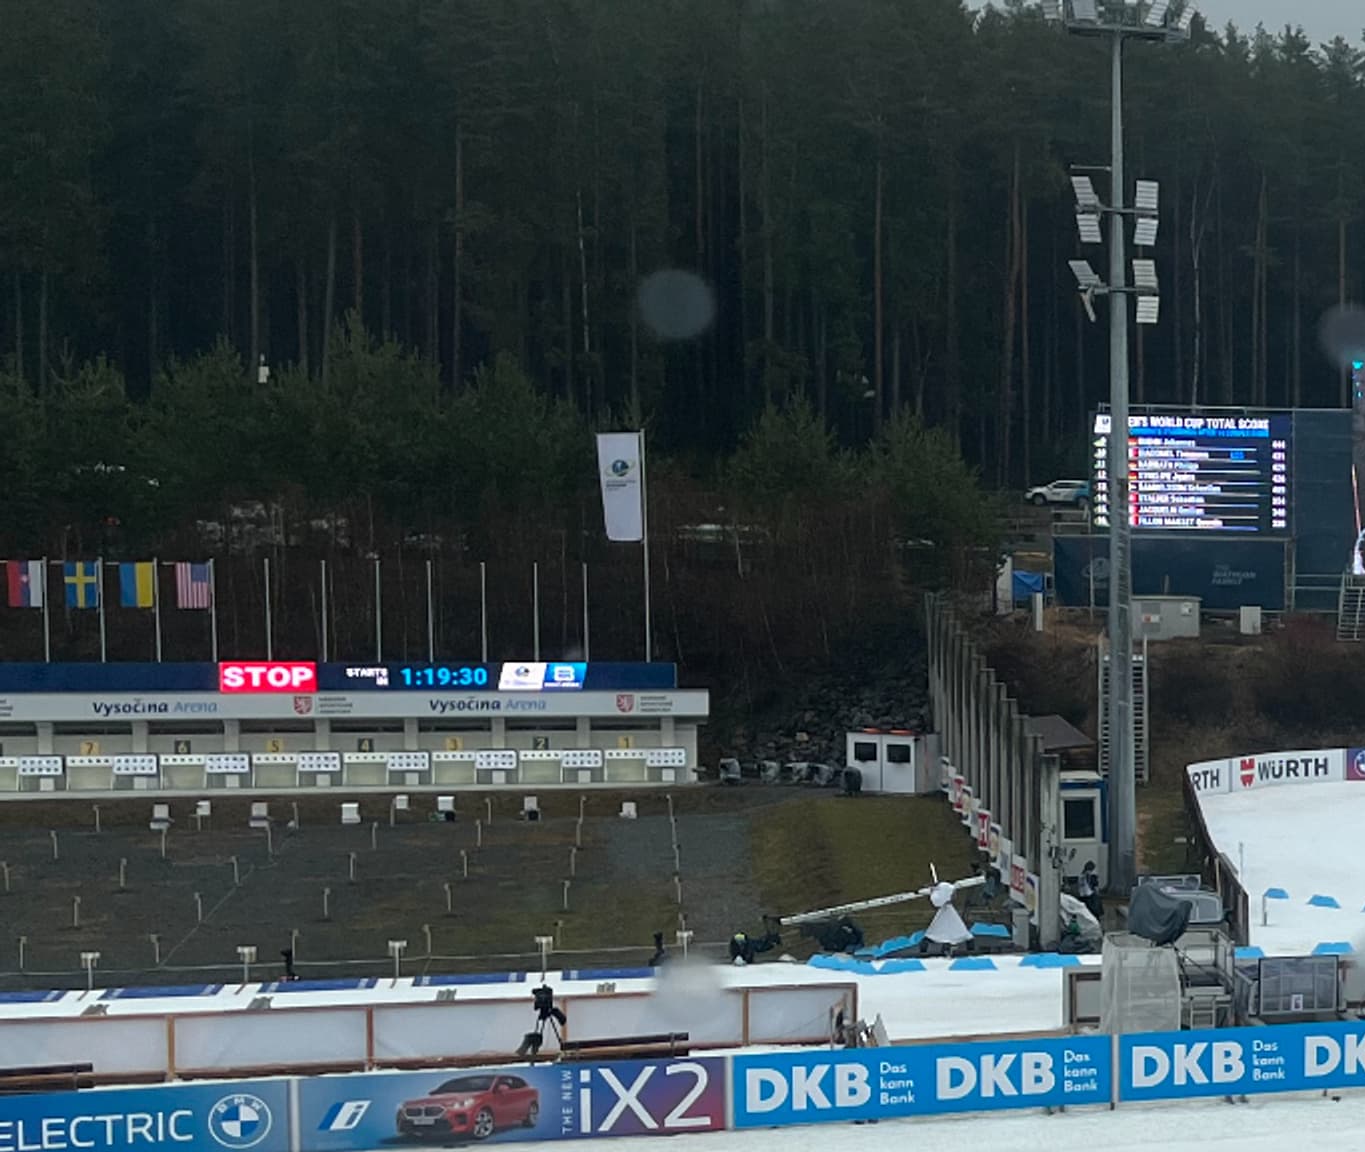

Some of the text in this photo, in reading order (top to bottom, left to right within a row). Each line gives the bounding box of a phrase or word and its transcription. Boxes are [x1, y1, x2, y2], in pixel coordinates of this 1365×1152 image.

[1127, 416, 1269, 430] EN'S WORLD CUP TOTAL SCORE
[223, 667, 313, 687] STOP
[346, 668, 388, 677] STARTS
[401, 667, 488, 686] 1:19:30
[93, 698, 218, 717] Vysočina Arena
[430, 697, 546, 713] Vysočina Arena
[1258, 757, 1329, 781] WÜRTH
[1253, 1039, 1278, 1052] Das
[1064, 1050, 1090, 1063] Das
[1253, 1054, 1285, 1066] kann
[880, 1061, 907, 1074] Das
[1064, 1065, 1097, 1078] kann
[1132, 1041, 1246, 1088] DKB
[936, 1052, 1056, 1100] DKB
[1253, 1067, 1286, 1081] Bank
[745, 1062, 872, 1113] DKB
[880, 1077, 914, 1090] kann
[1064, 1079, 1099, 1093] Bank
[562, 1069, 573, 1135] THE NEW
[579, 1062, 712, 1133] iX2
[880, 1092, 915, 1105] Bank
[0, 1110, 193, 1152] ELECTRIC
